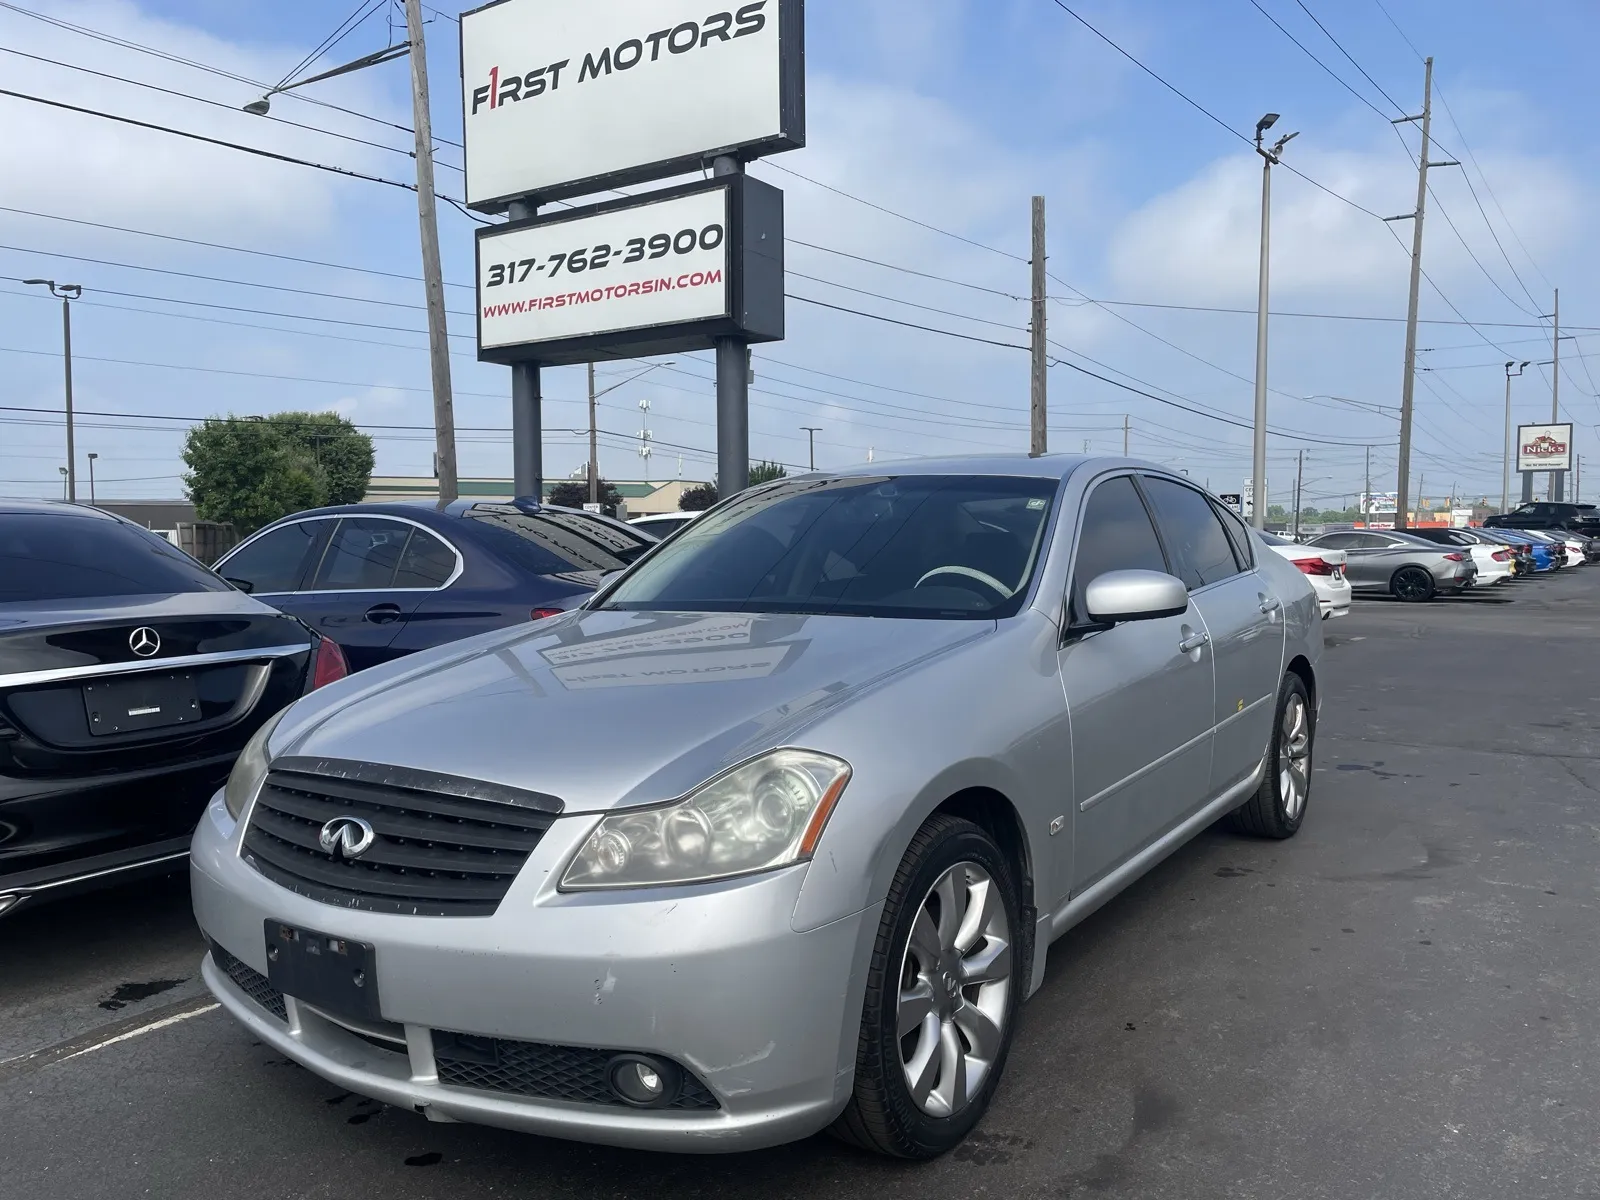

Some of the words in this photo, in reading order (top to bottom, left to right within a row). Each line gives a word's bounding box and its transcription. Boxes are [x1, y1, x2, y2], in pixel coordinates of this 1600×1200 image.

[578, 0, 767, 83] MOTORS
[486, 223, 724, 287] 317-762-3900
[483, 269, 722, 319] WWW.FIRSTMOTORSIN.COM
